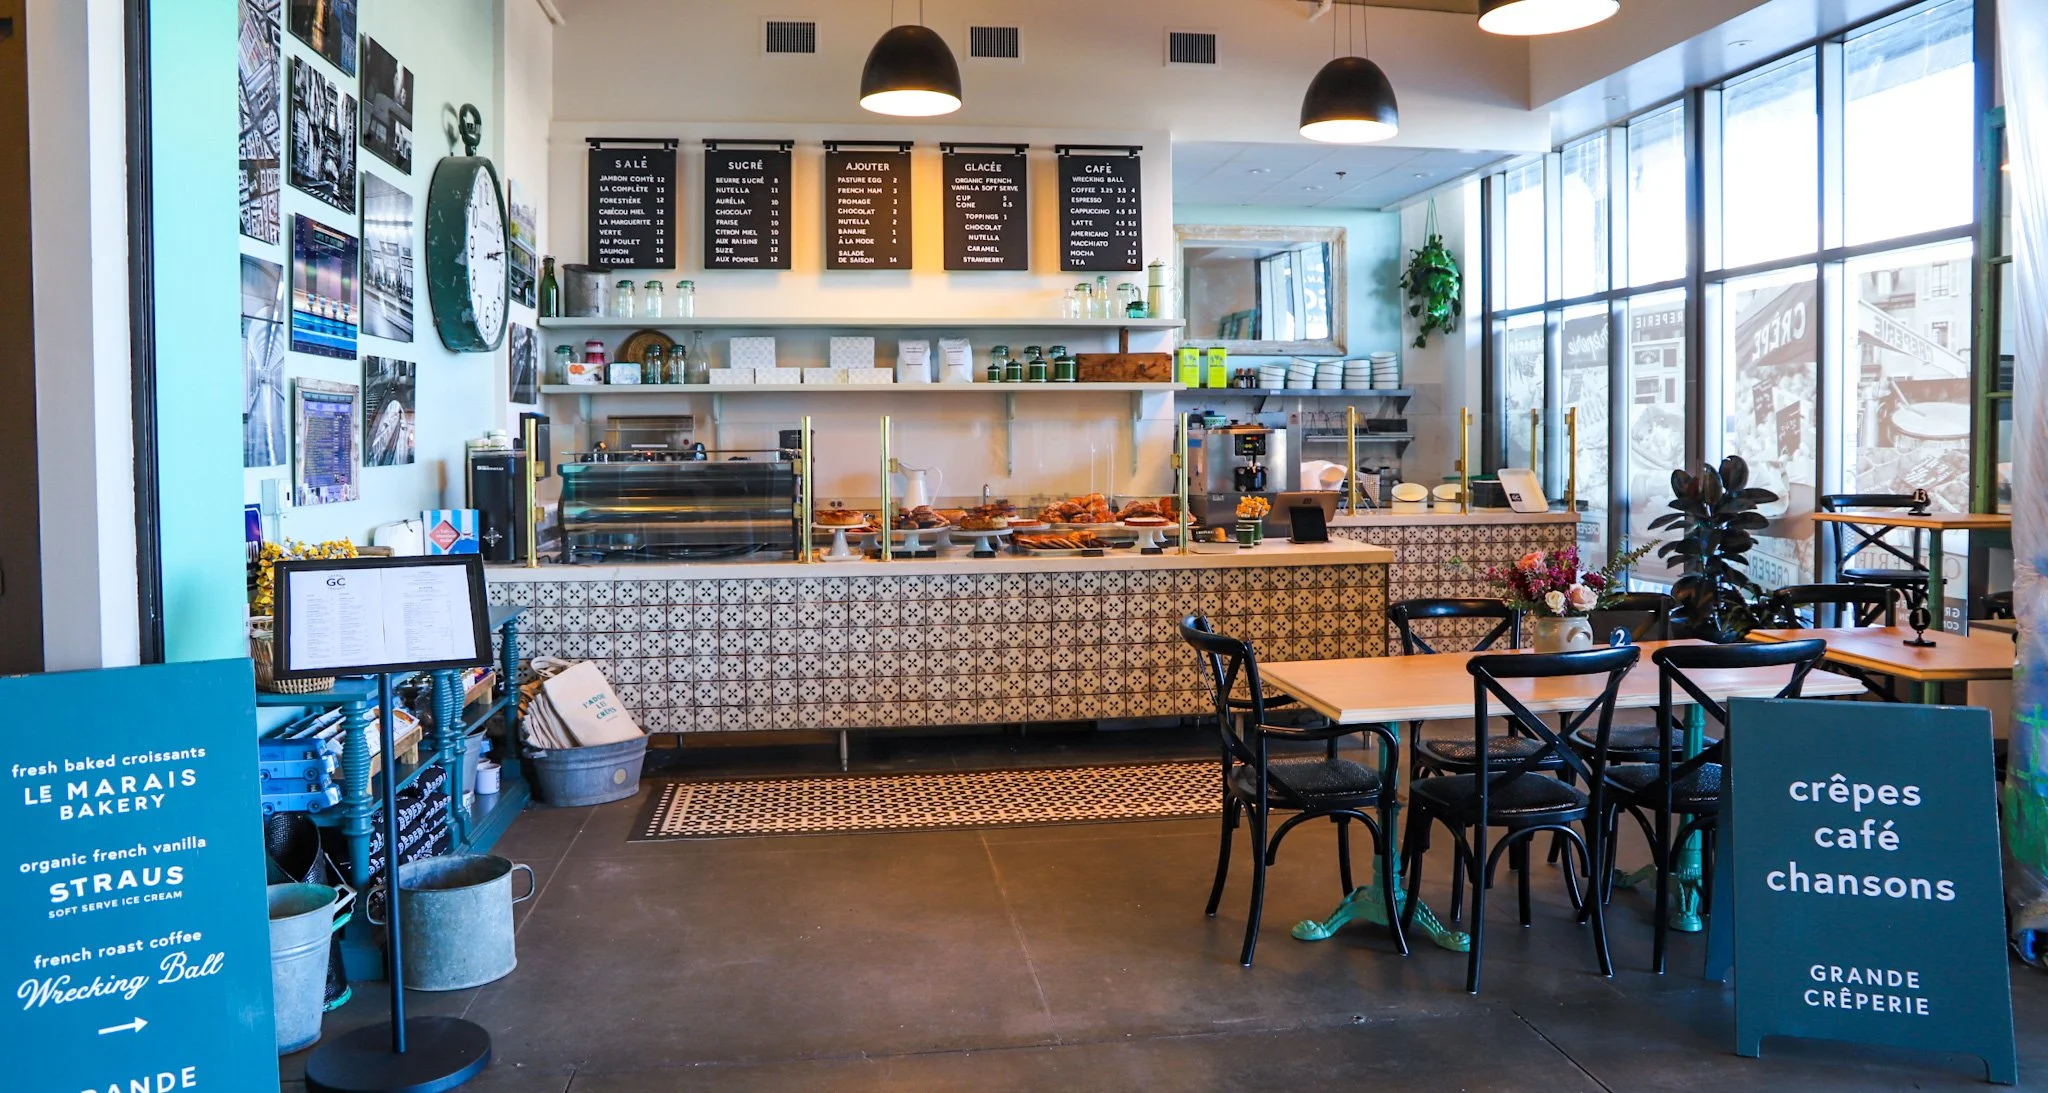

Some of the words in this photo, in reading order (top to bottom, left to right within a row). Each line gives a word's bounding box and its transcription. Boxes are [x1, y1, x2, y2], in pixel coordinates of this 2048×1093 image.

[616, 156, 647, 168] SALÉ
[728, 160, 763, 169] SUCRÉ
[846, 163, 890, 171] AJOUTER
[965, 161, 1001, 172] GLACÉE
[1085, 163, 1111, 173] CAFÉ
[1914, 491, 1928, 502] 13
[326, 578, 346, 586] GC
[1916, 610, 1924, 626] 1
[1615, 629, 1626, 646] 2
[12, 761, 57, 778] fresh
[65, 754, 115, 772] baked
[122, 748, 205, 765] croissants
[25, 785, 52, 805] LE
[67, 768, 197, 800] MARAIS
[1790, 773, 1921, 812] crêpes
[60, 794, 166, 820] BAKERY
[1815, 819, 1899, 850] café
[20, 853, 86, 873] organic
[93, 844, 146, 862] french
[153, 836, 206, 853] vanilla
[50, 866, 184, 903] STRAUS
[1767, 862, 1955, 901] chansons
[49, 906, 77, 918] SOFT
[82, 900, 118, 912] SERVE
[122, 896, 139, 905] ICE
[144, 891, 182, 902] CREAM
[34, 948, 91, 969] french
[99, 940, 143, 957] roast
[150, 931, 201, 948] coffee
[17, 975, 149, 1010] Wrecking
[158, 951, 224, 984] Ball
[1810, 965, 1919, 988] GRANDE
[1805, 987, 1929, 1015] CRÊPERIE
